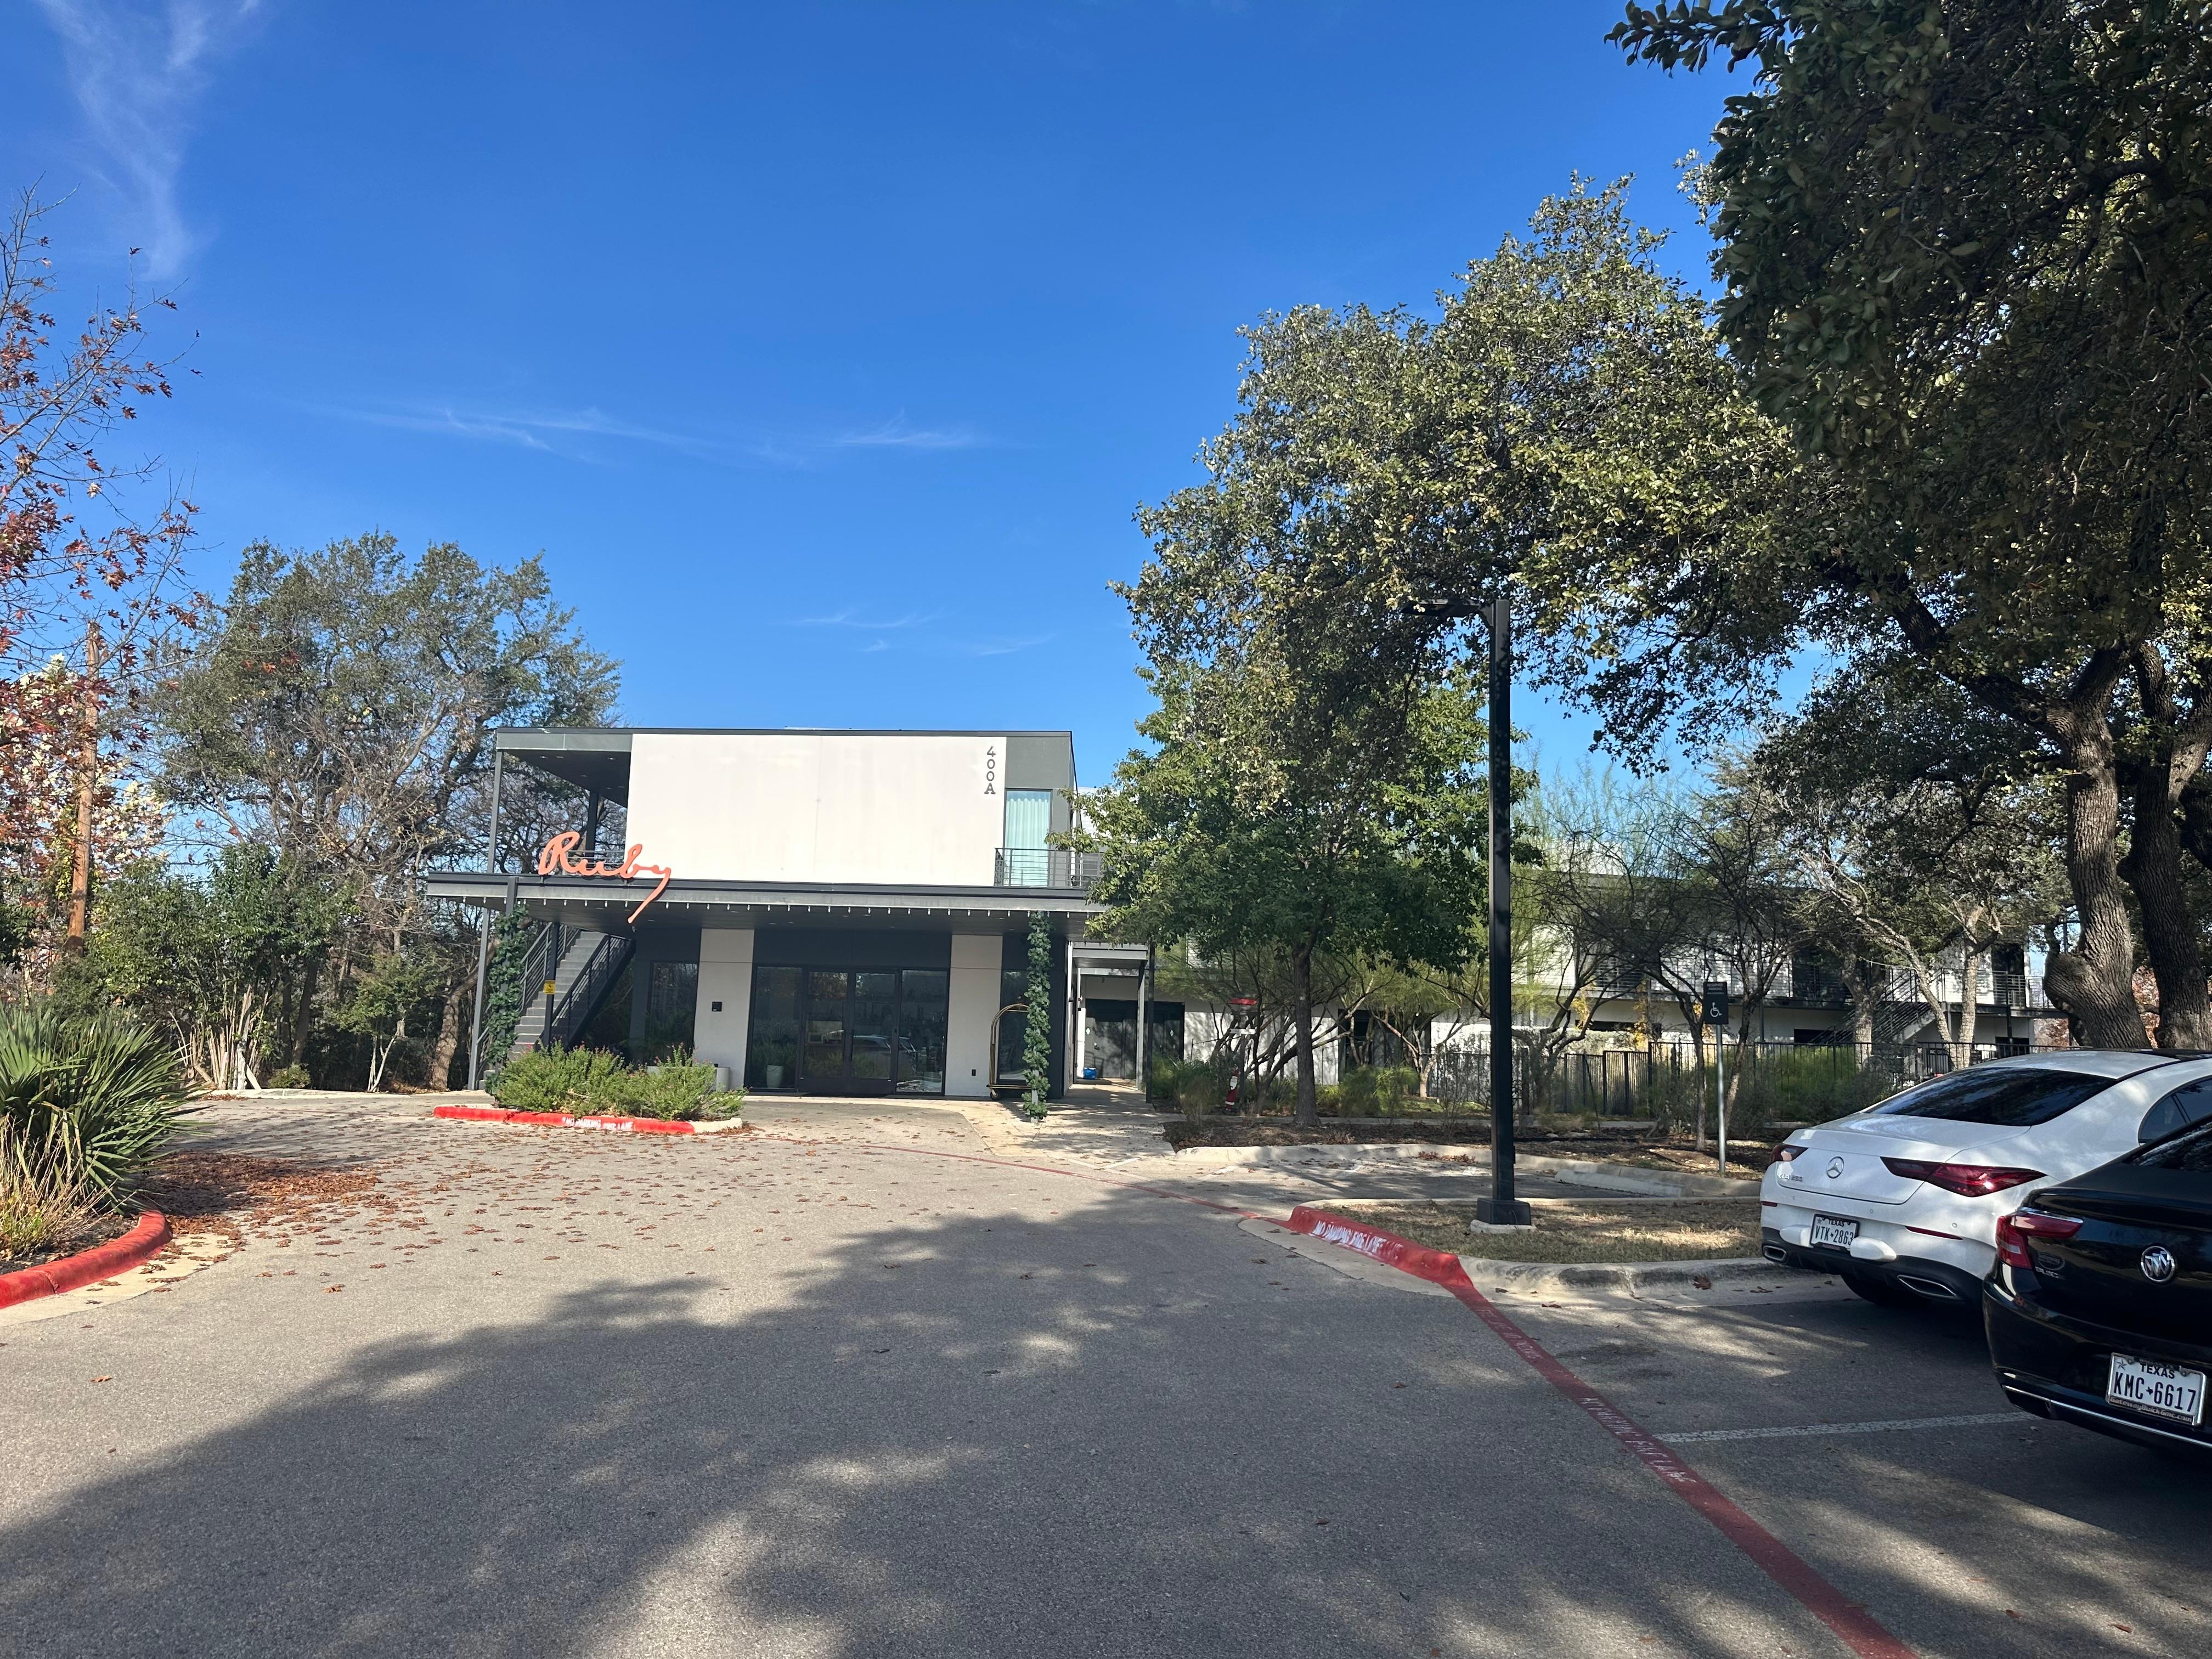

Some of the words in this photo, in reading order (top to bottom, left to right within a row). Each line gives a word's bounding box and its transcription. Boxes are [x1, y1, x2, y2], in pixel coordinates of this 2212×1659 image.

[984, 746, 996, 794] 400A
[538, 831, 671, 923] Ruby
[1312, 1220, 1326, 1235] NO
[2140, 1363, 2175, 1379] TEXAS
